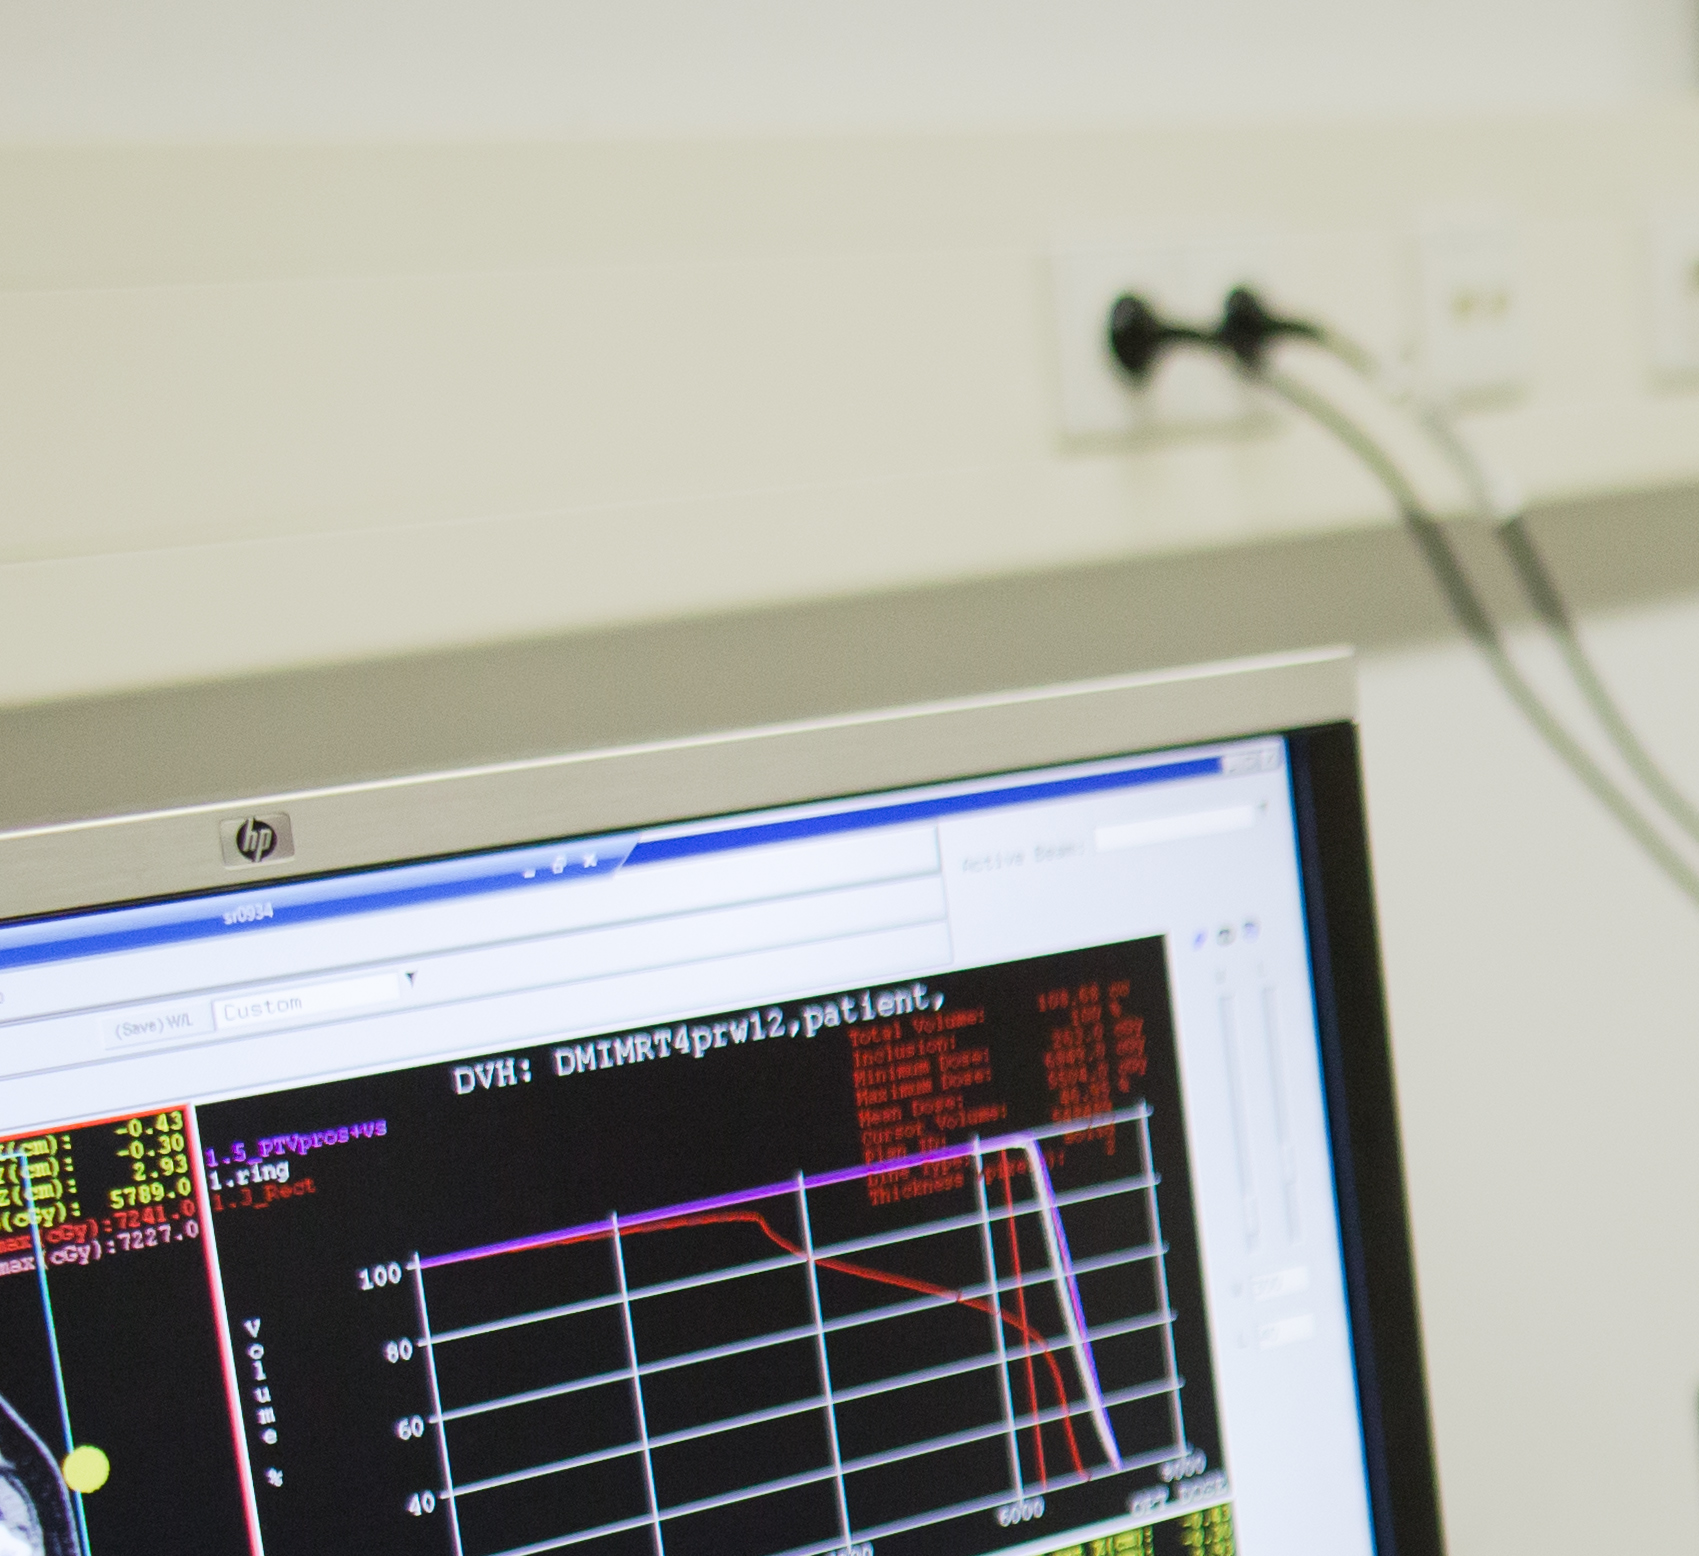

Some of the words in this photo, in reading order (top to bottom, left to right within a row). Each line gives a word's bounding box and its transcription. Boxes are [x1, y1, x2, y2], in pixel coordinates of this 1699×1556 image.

[242, 817, 273, 863] hp
[223, 997, 303, 1022] Custom
[115, 1016, 164, 1040] (Save)
[453, 1057, 532, 1095] DVH:
[0, 1134, 72, 1162] (cm):
[114, 1110, 184, 1138] -0.43
[116, 1132, 185, 1160] -0.30
[131, 1153, 188, 1182] 2.93
[208, 1160, 290, 1191] 1.ring
[109, 1176, 192, 1209] 5789.0
[358, 1261, 402, 1291] 100
[385, 1336, 413, 1364] 80
[395, 1414, 425, 1441] 60
[407, 1489, 436, 1516] 40
